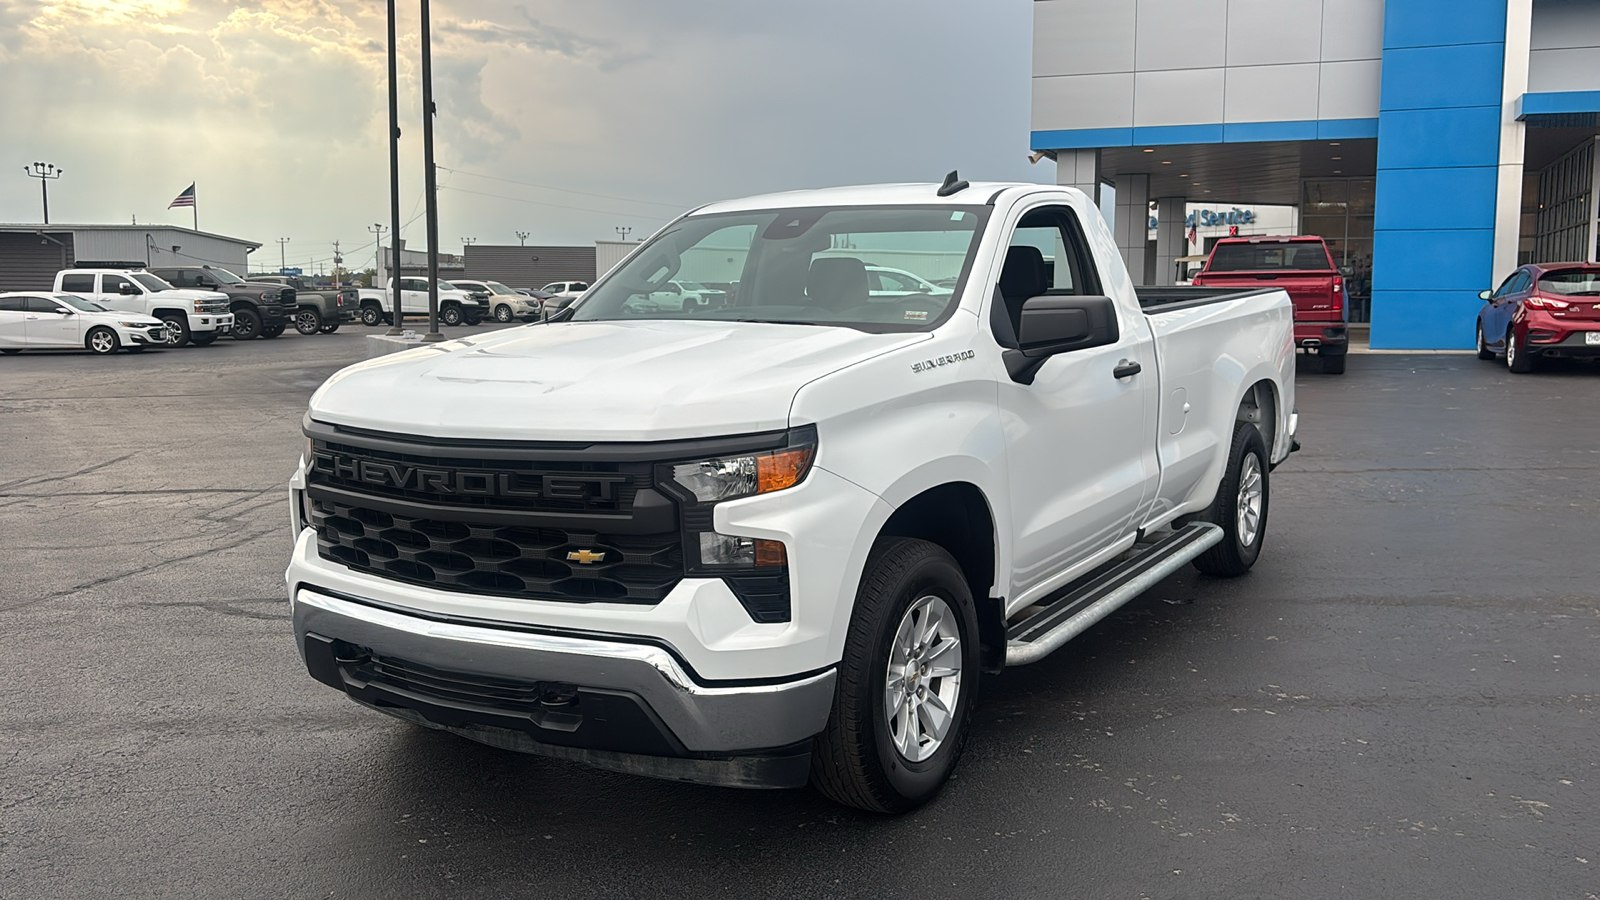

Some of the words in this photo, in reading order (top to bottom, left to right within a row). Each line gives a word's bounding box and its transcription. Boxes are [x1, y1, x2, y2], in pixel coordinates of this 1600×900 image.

[1200, 206, 1253, 227] Service
[910, 349, 976, 374] SILVERADO
[313, 451, 627, 499] CHEVROLET
